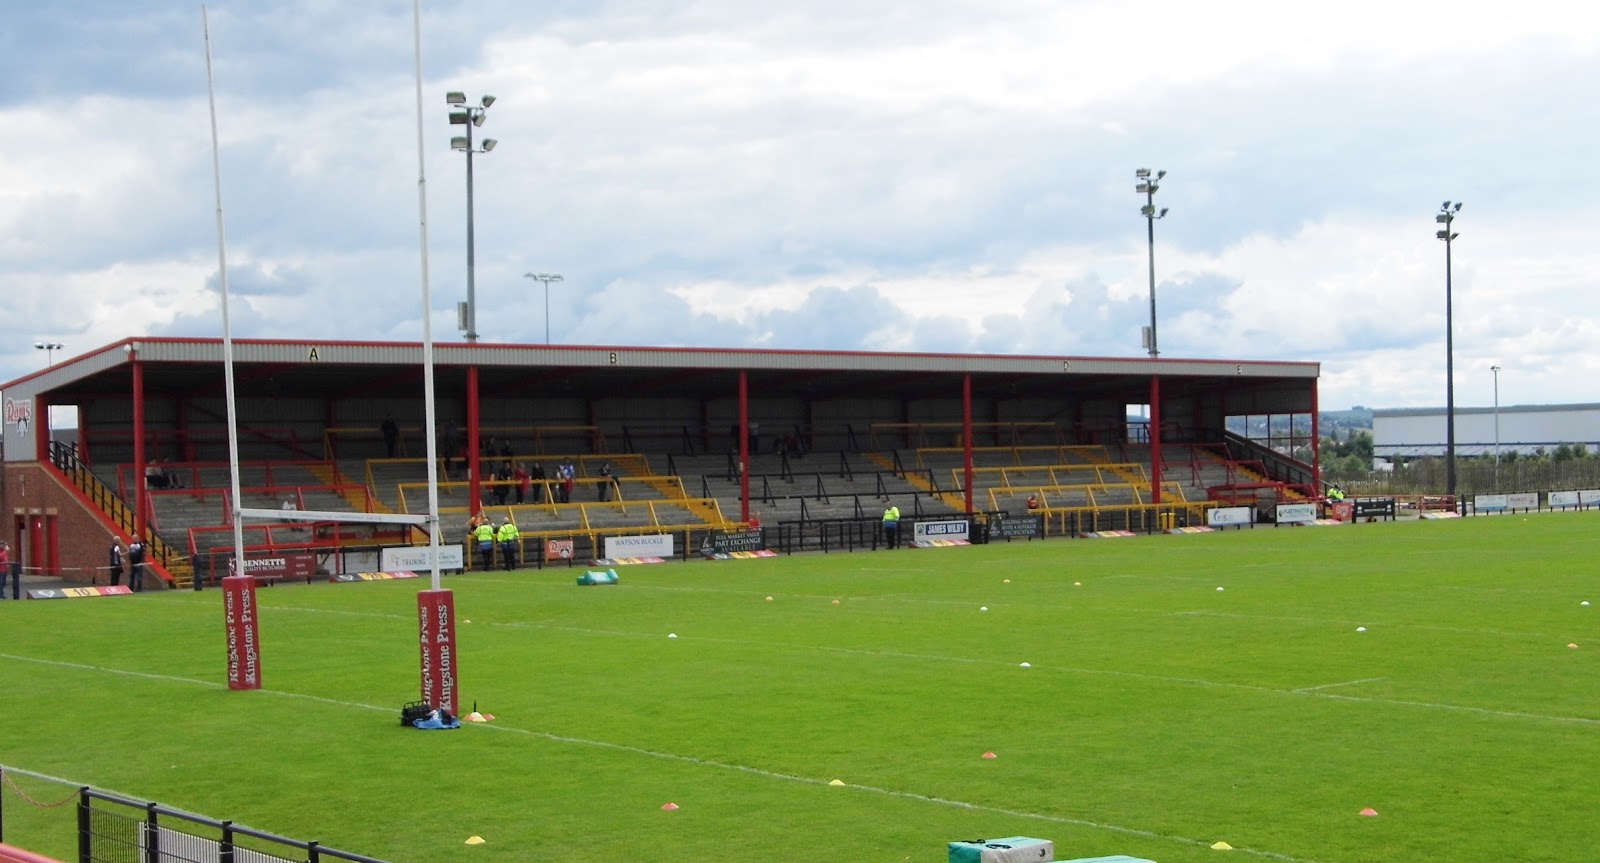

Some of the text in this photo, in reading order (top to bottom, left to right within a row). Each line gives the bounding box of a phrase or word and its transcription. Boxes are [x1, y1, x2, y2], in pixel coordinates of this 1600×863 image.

[309, 347, 319, 361] A
[609, 352, 617, 364] B
[1063, 361, 1069, 371] D
[1236, 365, 1242, 375] E
[928, 523, 964, 533] JAMES WILBY
[730, 537, 761, 545] EXCHANGE
[243, 558, 286, 566] BENNETTS
[74, 587, 91, 596] 10
[242, 588, 257, 684] Kingstone Press
[229, 626, 239, 682] Kingstone
[421, 606, 433, 705] ingstone Press
[437, 604, 454, 711] Kingstone Press
